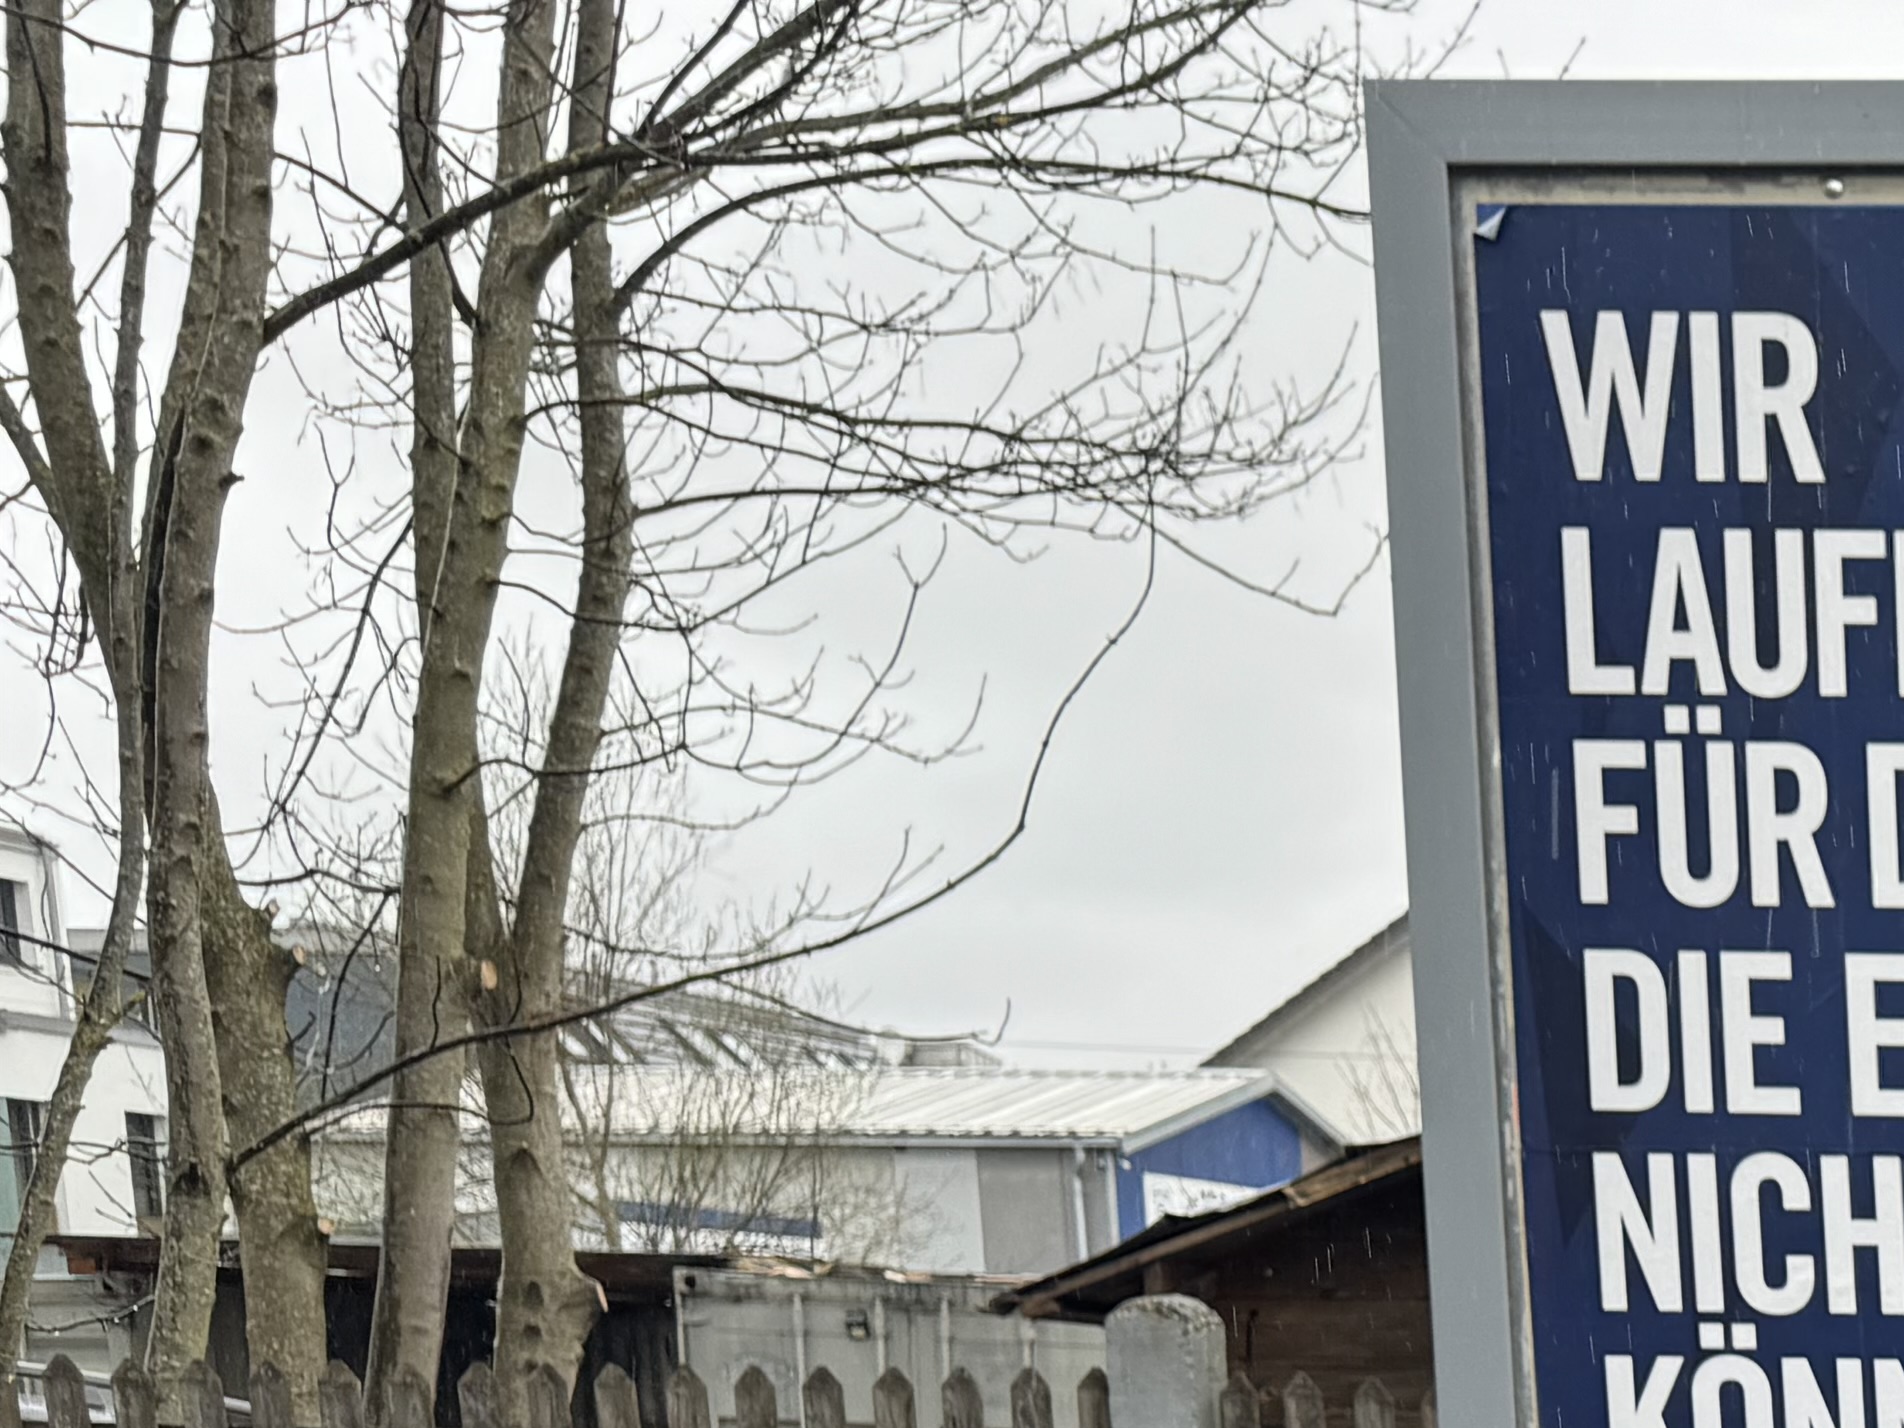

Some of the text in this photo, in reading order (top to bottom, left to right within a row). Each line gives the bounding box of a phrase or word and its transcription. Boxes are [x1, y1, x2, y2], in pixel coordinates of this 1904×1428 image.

[1540, 309, 1826, 483] WIR
[1572, 703, 1836, 909] FÜR
[1583, 947, 1802, 1116] DIE
